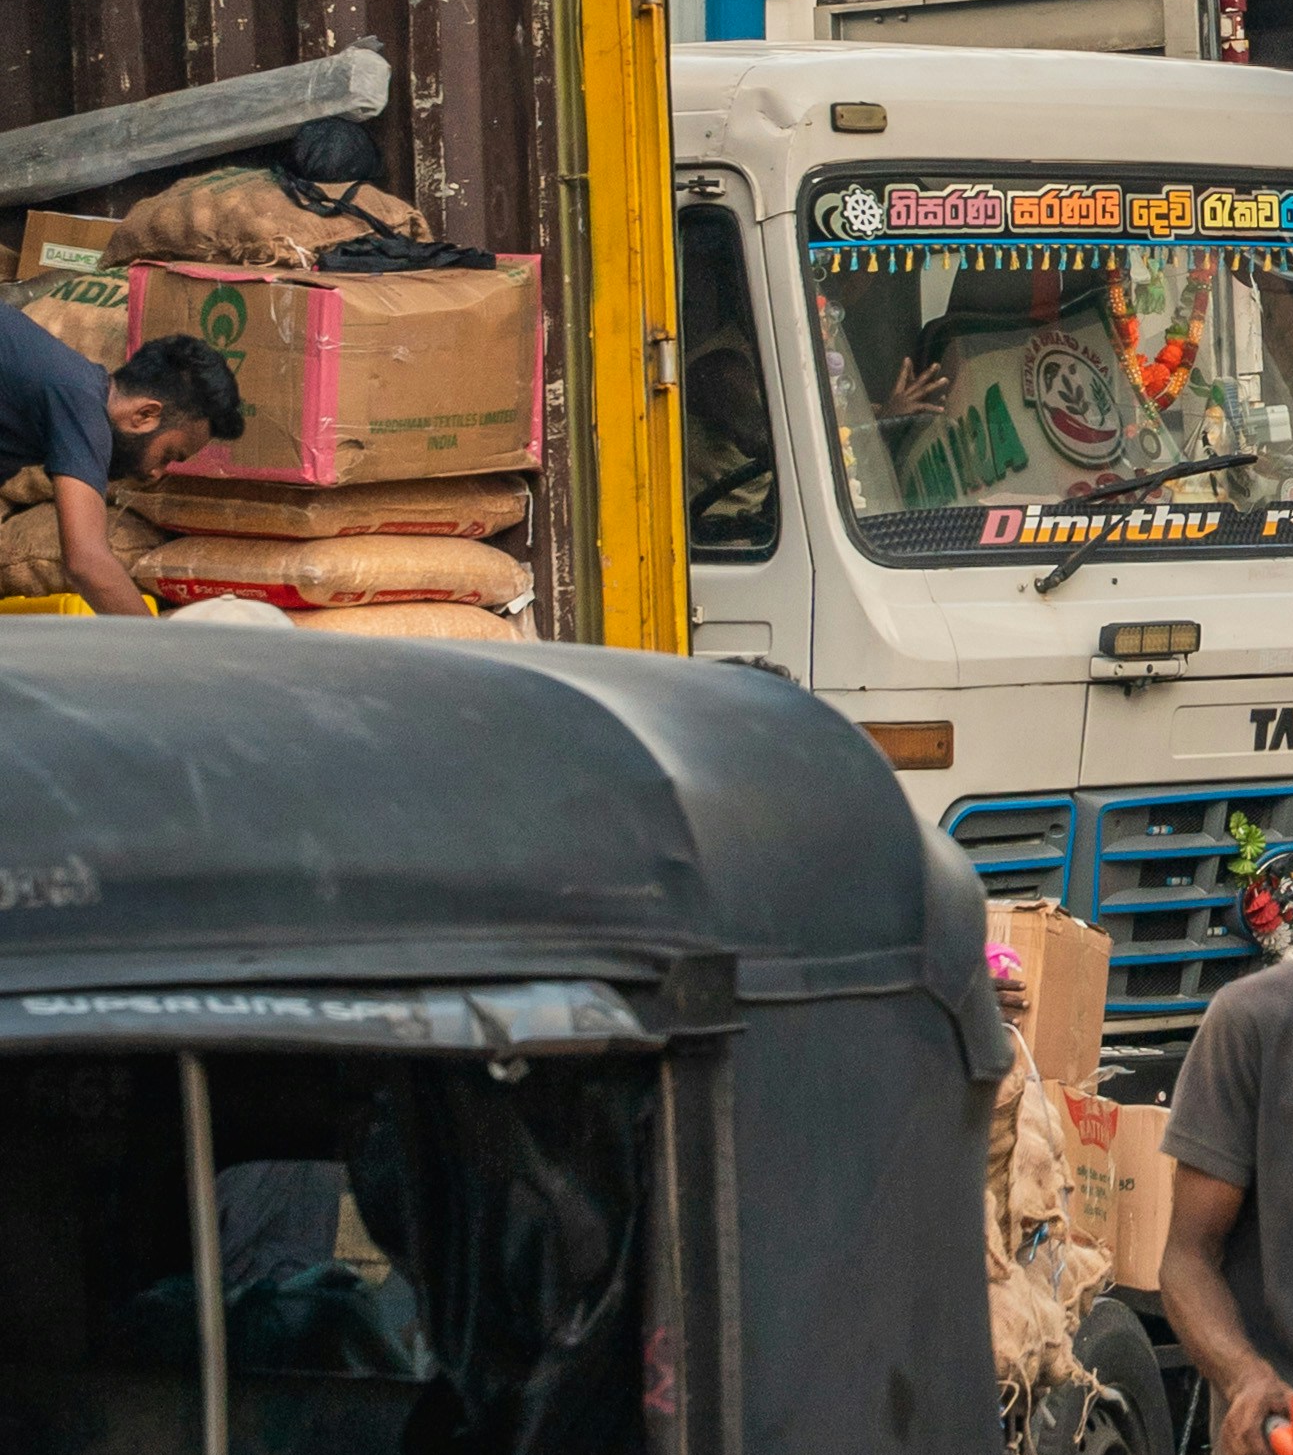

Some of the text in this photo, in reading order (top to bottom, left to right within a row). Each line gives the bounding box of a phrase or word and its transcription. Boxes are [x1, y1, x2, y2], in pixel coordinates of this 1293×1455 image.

[1013, 189, 1121, 227] සරණයි
[432, 413, 478, 428] TEXTILES
[479, 408, 518, 426] LIMITED
[427, 435, 458, 451] INDIA
[979, 505, 1221, 545] Dimuthu
[21, 996, 199, 1016] SUPER
